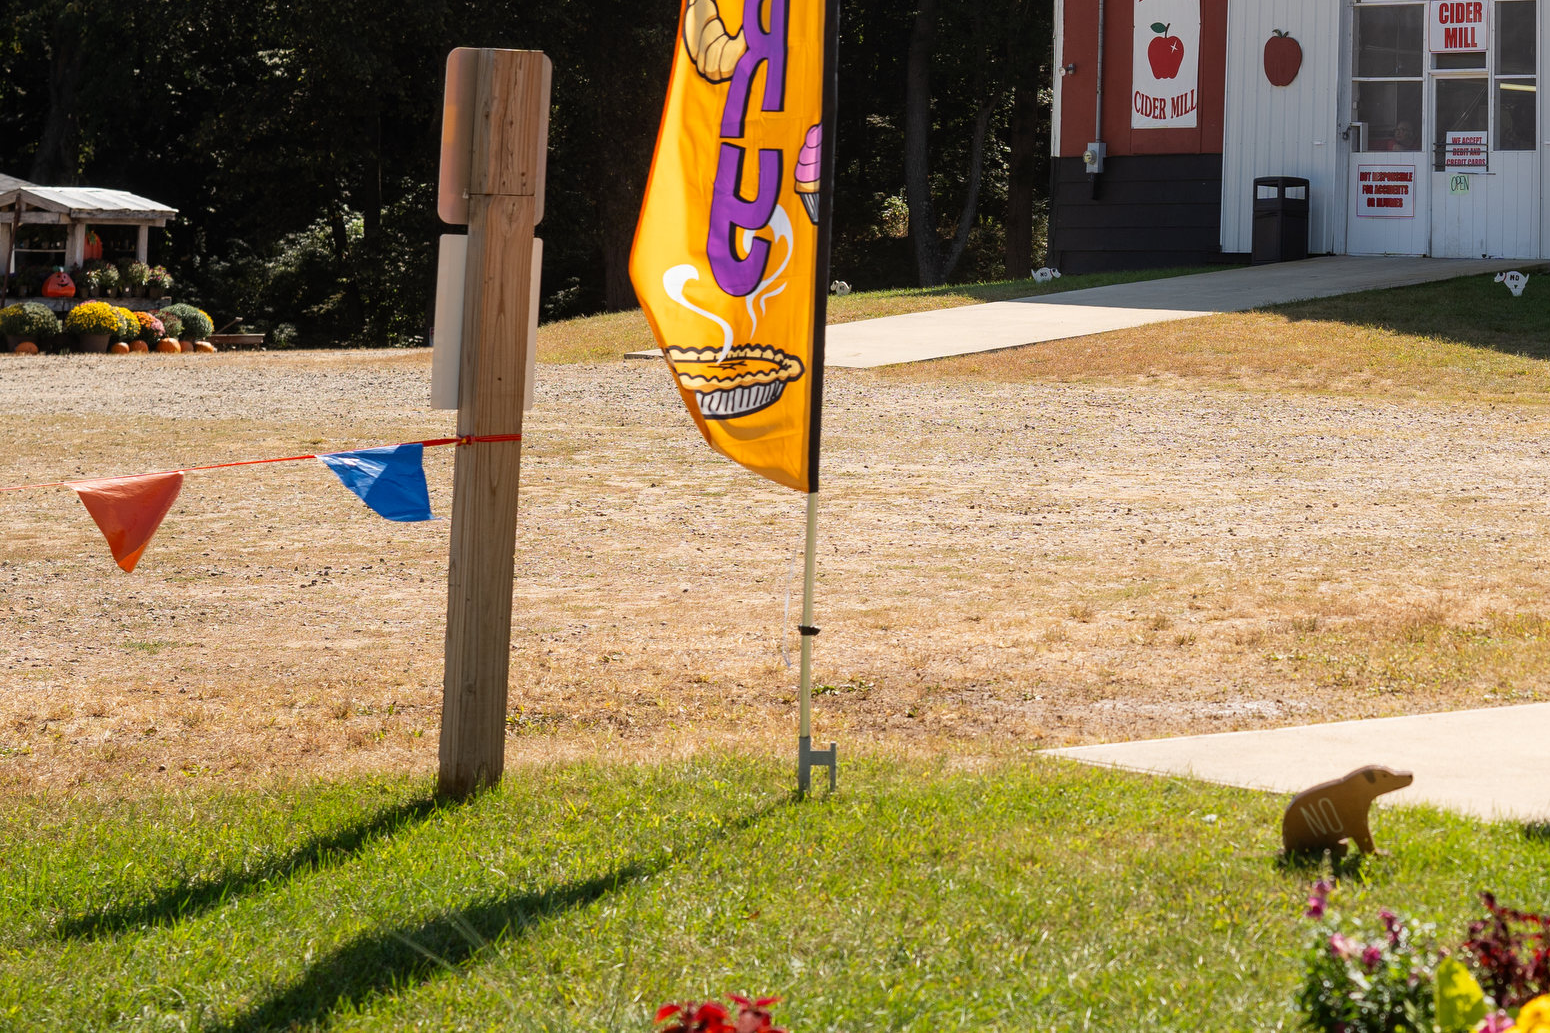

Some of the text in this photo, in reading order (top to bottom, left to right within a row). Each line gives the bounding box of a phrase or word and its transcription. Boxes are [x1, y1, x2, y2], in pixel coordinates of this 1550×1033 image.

[1439, 2, 1482, 24] CIDER
[1445, 27, 1477, 48] MILL
[1134, 89, 1197, 120] CIDER MILL
[1447, 159, 1485, 167] CREDIT CARDS
[1451, 175, 1469, 192] OPEN
